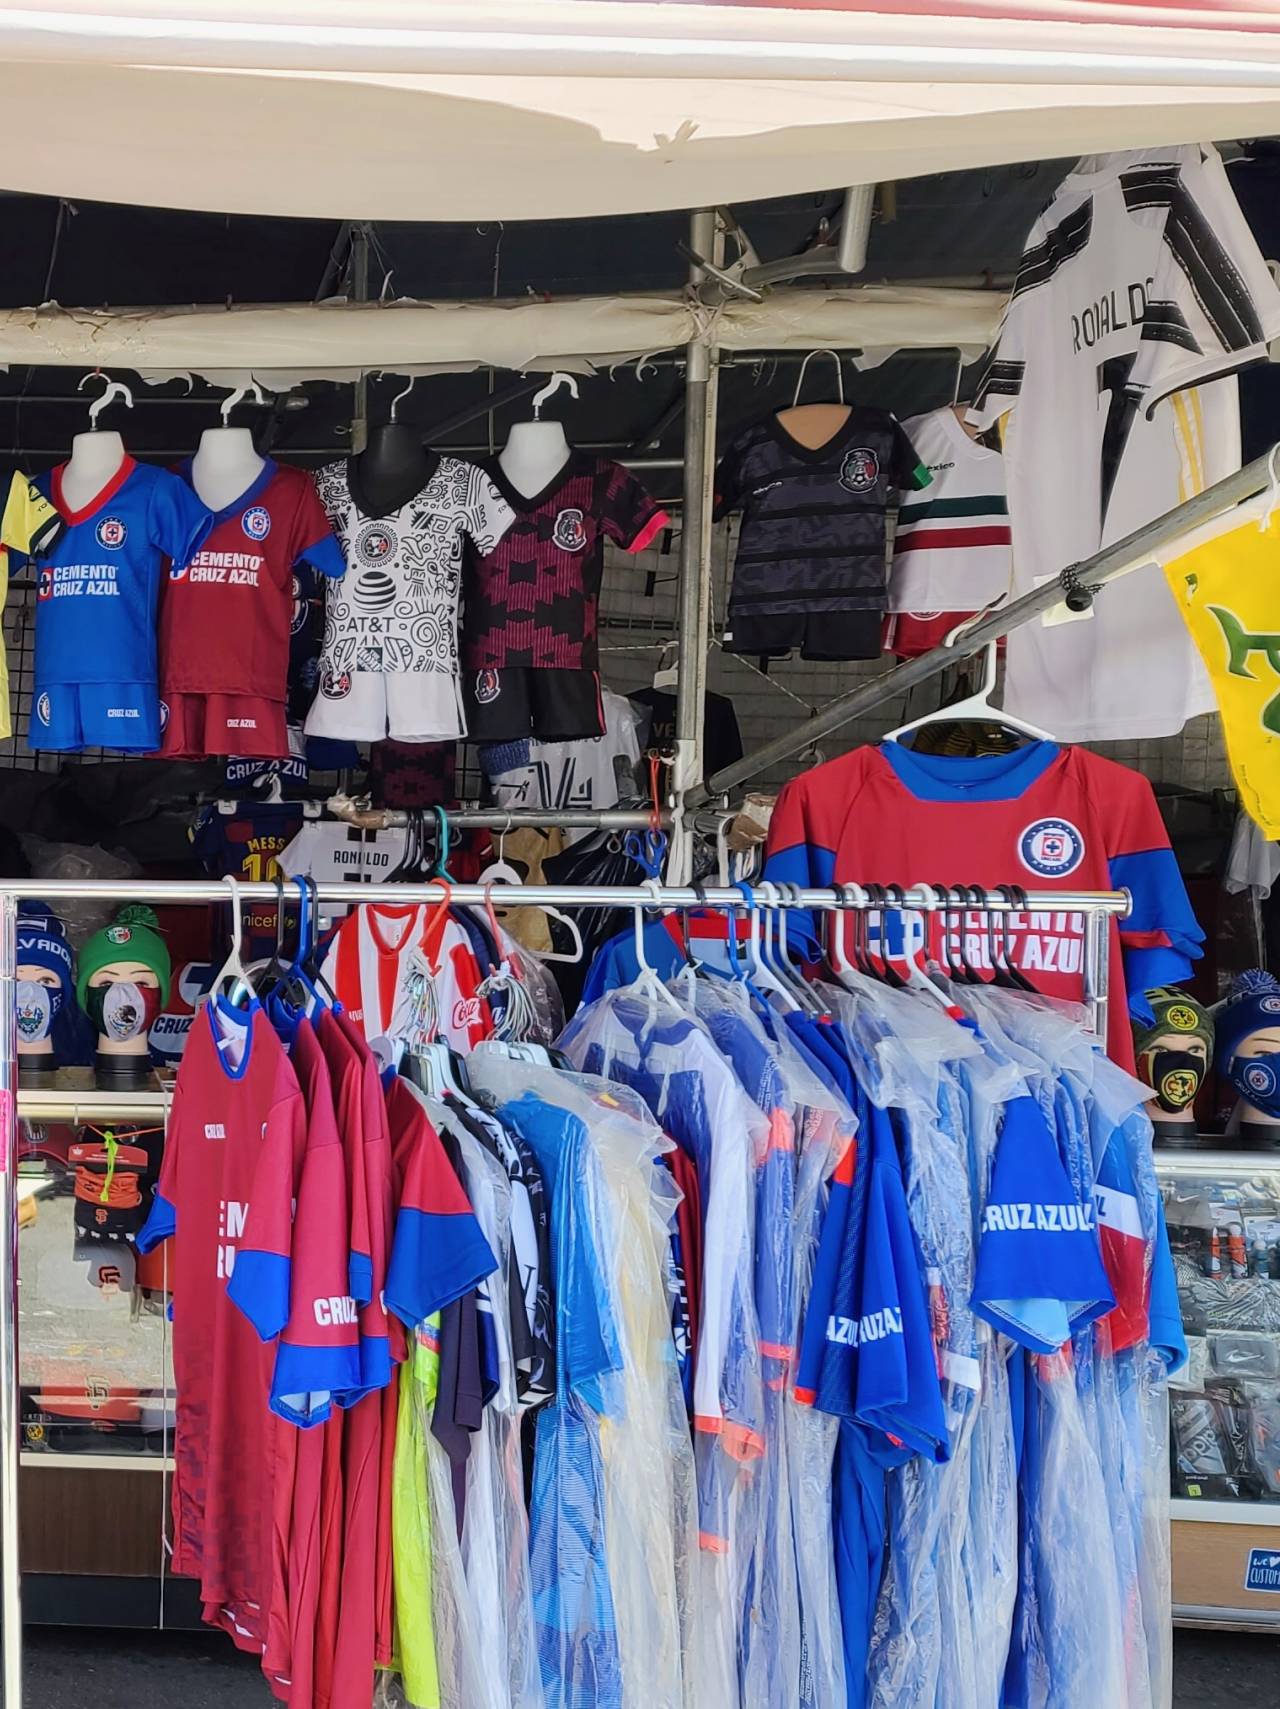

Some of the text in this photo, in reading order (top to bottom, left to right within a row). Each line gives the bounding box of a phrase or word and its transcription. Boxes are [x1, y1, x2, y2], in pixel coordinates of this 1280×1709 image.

[53, 564, 117, 582] CEMENTO
[189, 567, 260, 587] CRUZ AZUL
[53, 581, 120, 597] CRUZ AZUL
[346, 616, 396, 633] AT&T
[226, 761, 266, 780] CRUZ
[1022, 934, 1084, 974] AZU
[313, 1296, 358, 1326] CRUZ
